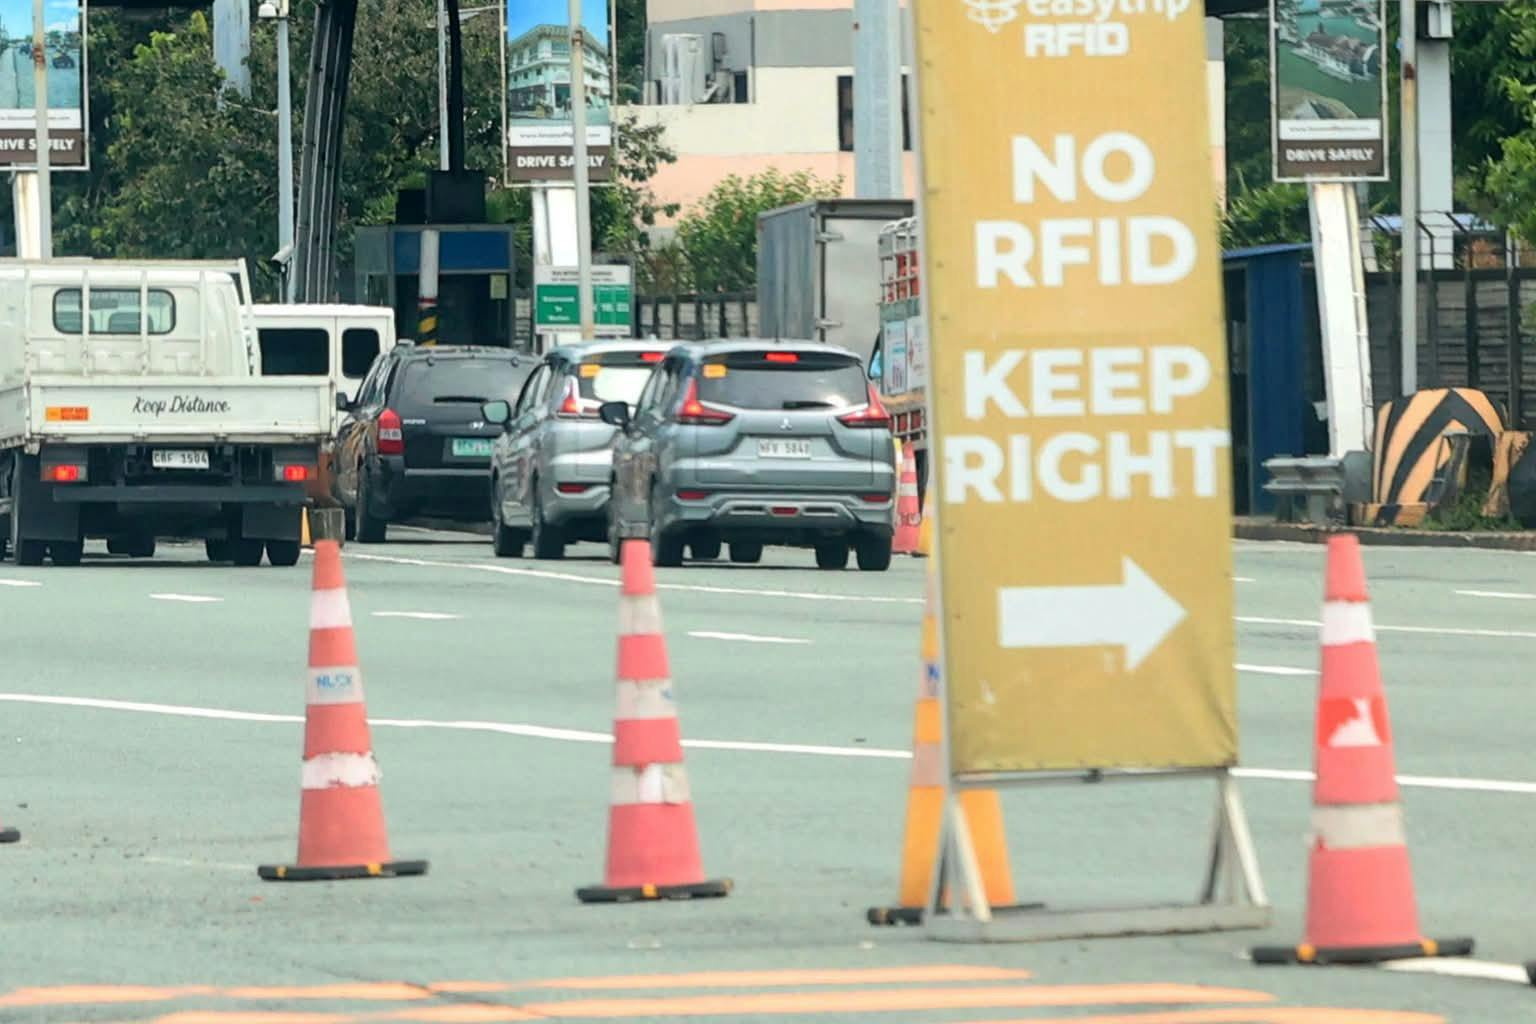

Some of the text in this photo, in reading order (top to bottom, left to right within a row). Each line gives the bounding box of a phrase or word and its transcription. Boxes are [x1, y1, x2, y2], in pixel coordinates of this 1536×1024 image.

[1024, 22, 1129, 58] RFID
[516, 155, 555, 168] DRIVE
[1010, 131, 1155, 205] NO
[1286, 147, 1374, 162] DRIVE SAFELY
[975, 216, 1198, 288] RFID
[133, 396, 165, 416] Keep
[964, 345, 1211, 420] KEEP
[942, 428, 1232, 506] RIGHT
